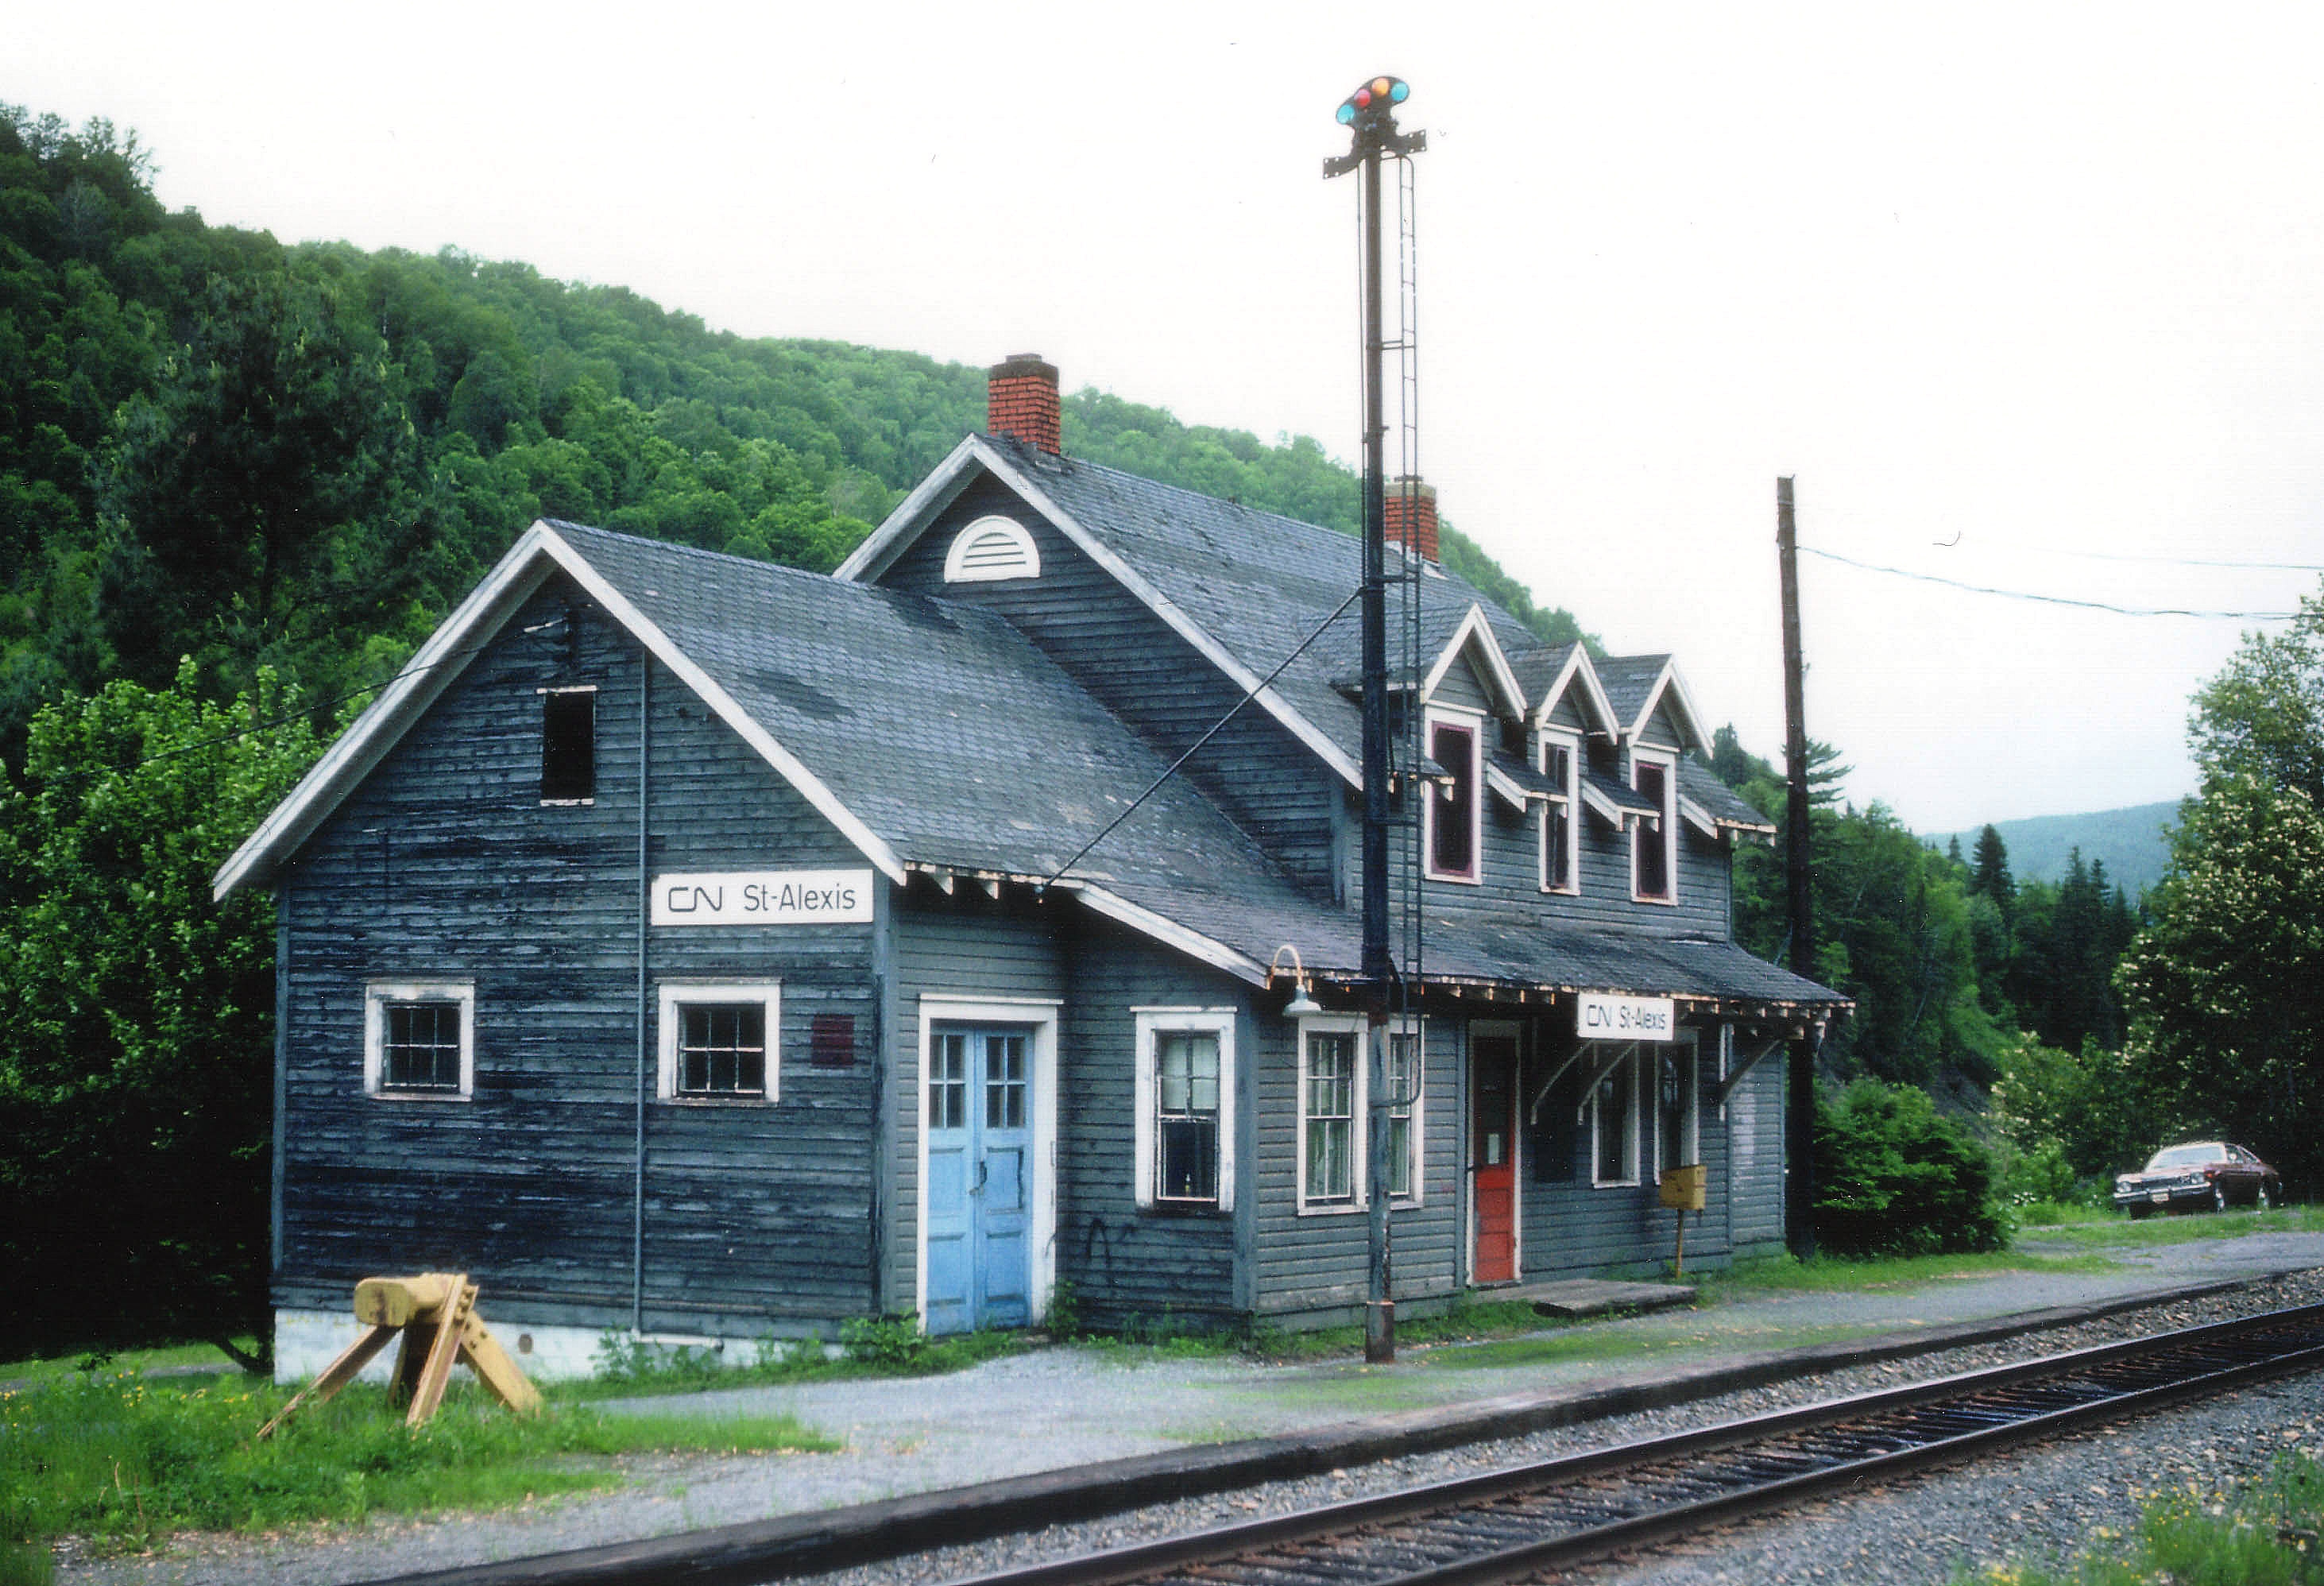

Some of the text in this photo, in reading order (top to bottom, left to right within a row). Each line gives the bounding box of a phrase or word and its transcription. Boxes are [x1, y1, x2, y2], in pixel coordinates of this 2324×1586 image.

[668, 883, 856, 912] CN St-Alexis
[1587, 1004, 1666, 1030] CN St-Alexis
